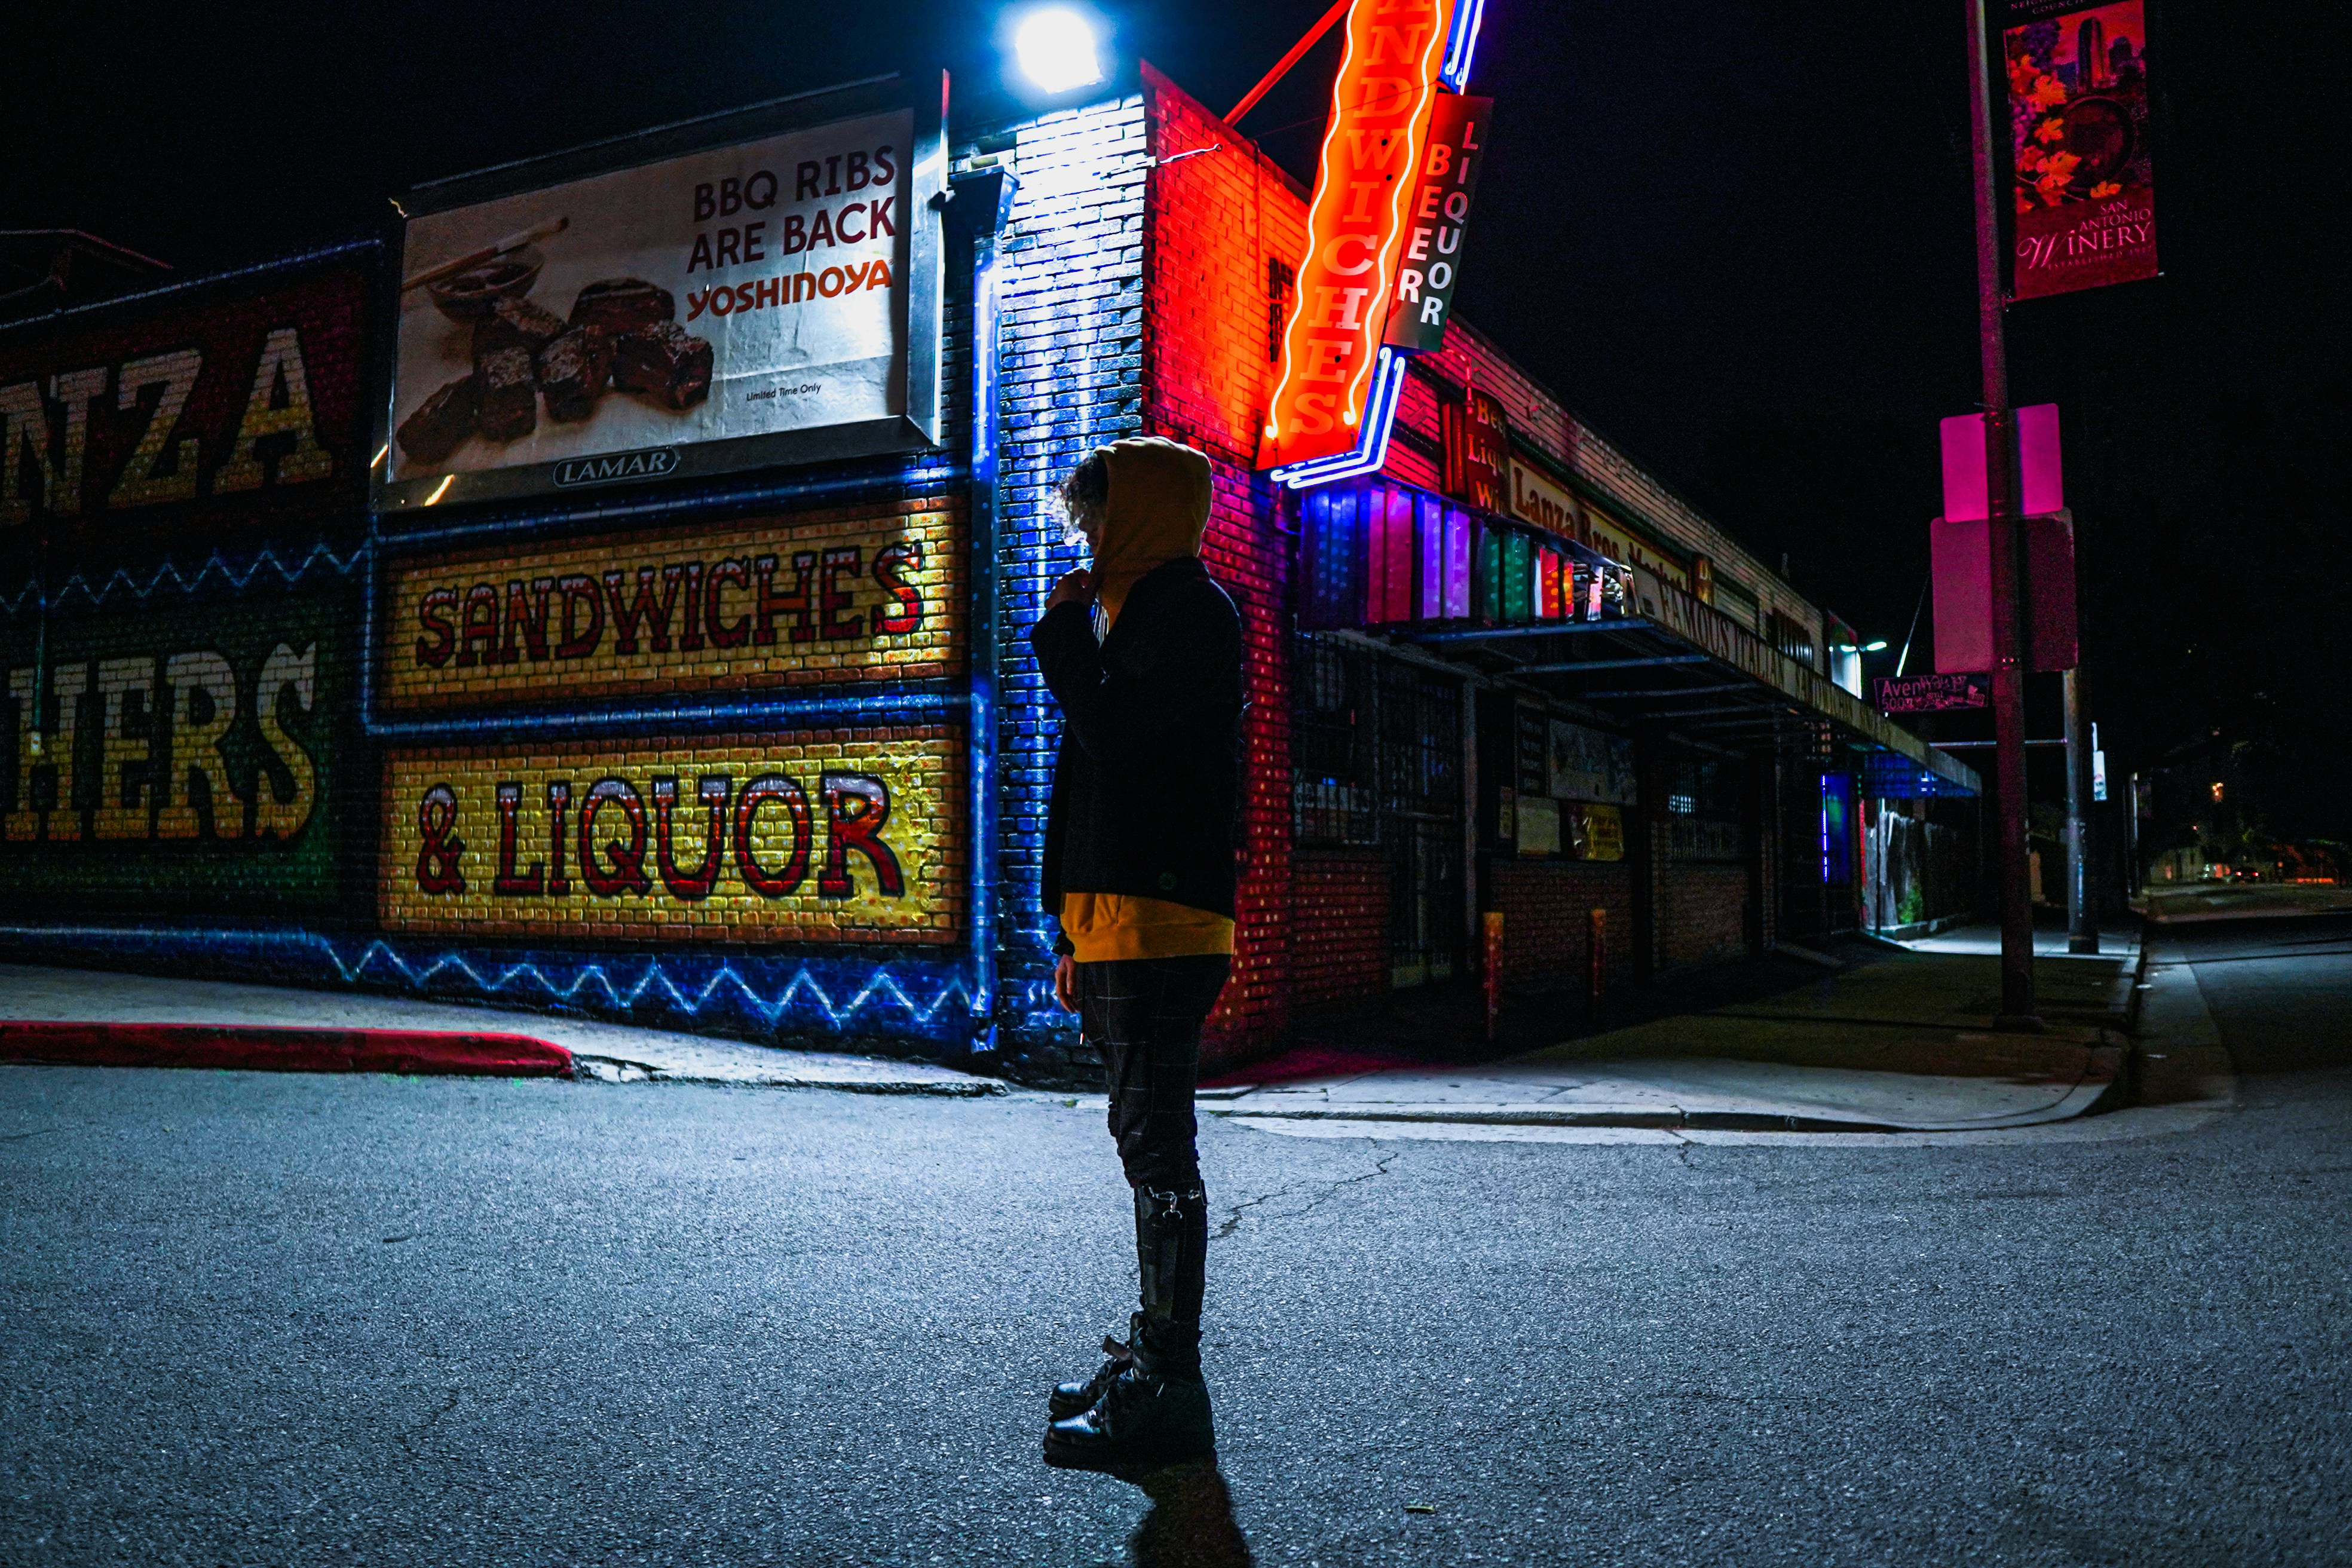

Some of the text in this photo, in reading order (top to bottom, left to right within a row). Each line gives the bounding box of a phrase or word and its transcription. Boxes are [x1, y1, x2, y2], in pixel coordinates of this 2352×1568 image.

[694, 145, 896, 223] BBQ RIBS
[2080, 209, 2151, 232] ANTONIO
[2100, 200, 2128, 215] SAN
[687, 196, 896, 274] ARE BACK
[1399, 143, 1451, 304] BEER
[1420, 121, 1478, 326] LIQUOR
[687, 259, 893, 322] YOSHINOYA
[0, 327, 332, 526] NZA
[746, 382, 822, 402] Limited Time Only
[563, 450, 667, 483] LAMAR
[416, 540, 924, 669] SANDWICHES
[4, 640, 317, 841] HERS
[416, 772, 905, 901] & LIQUOR
